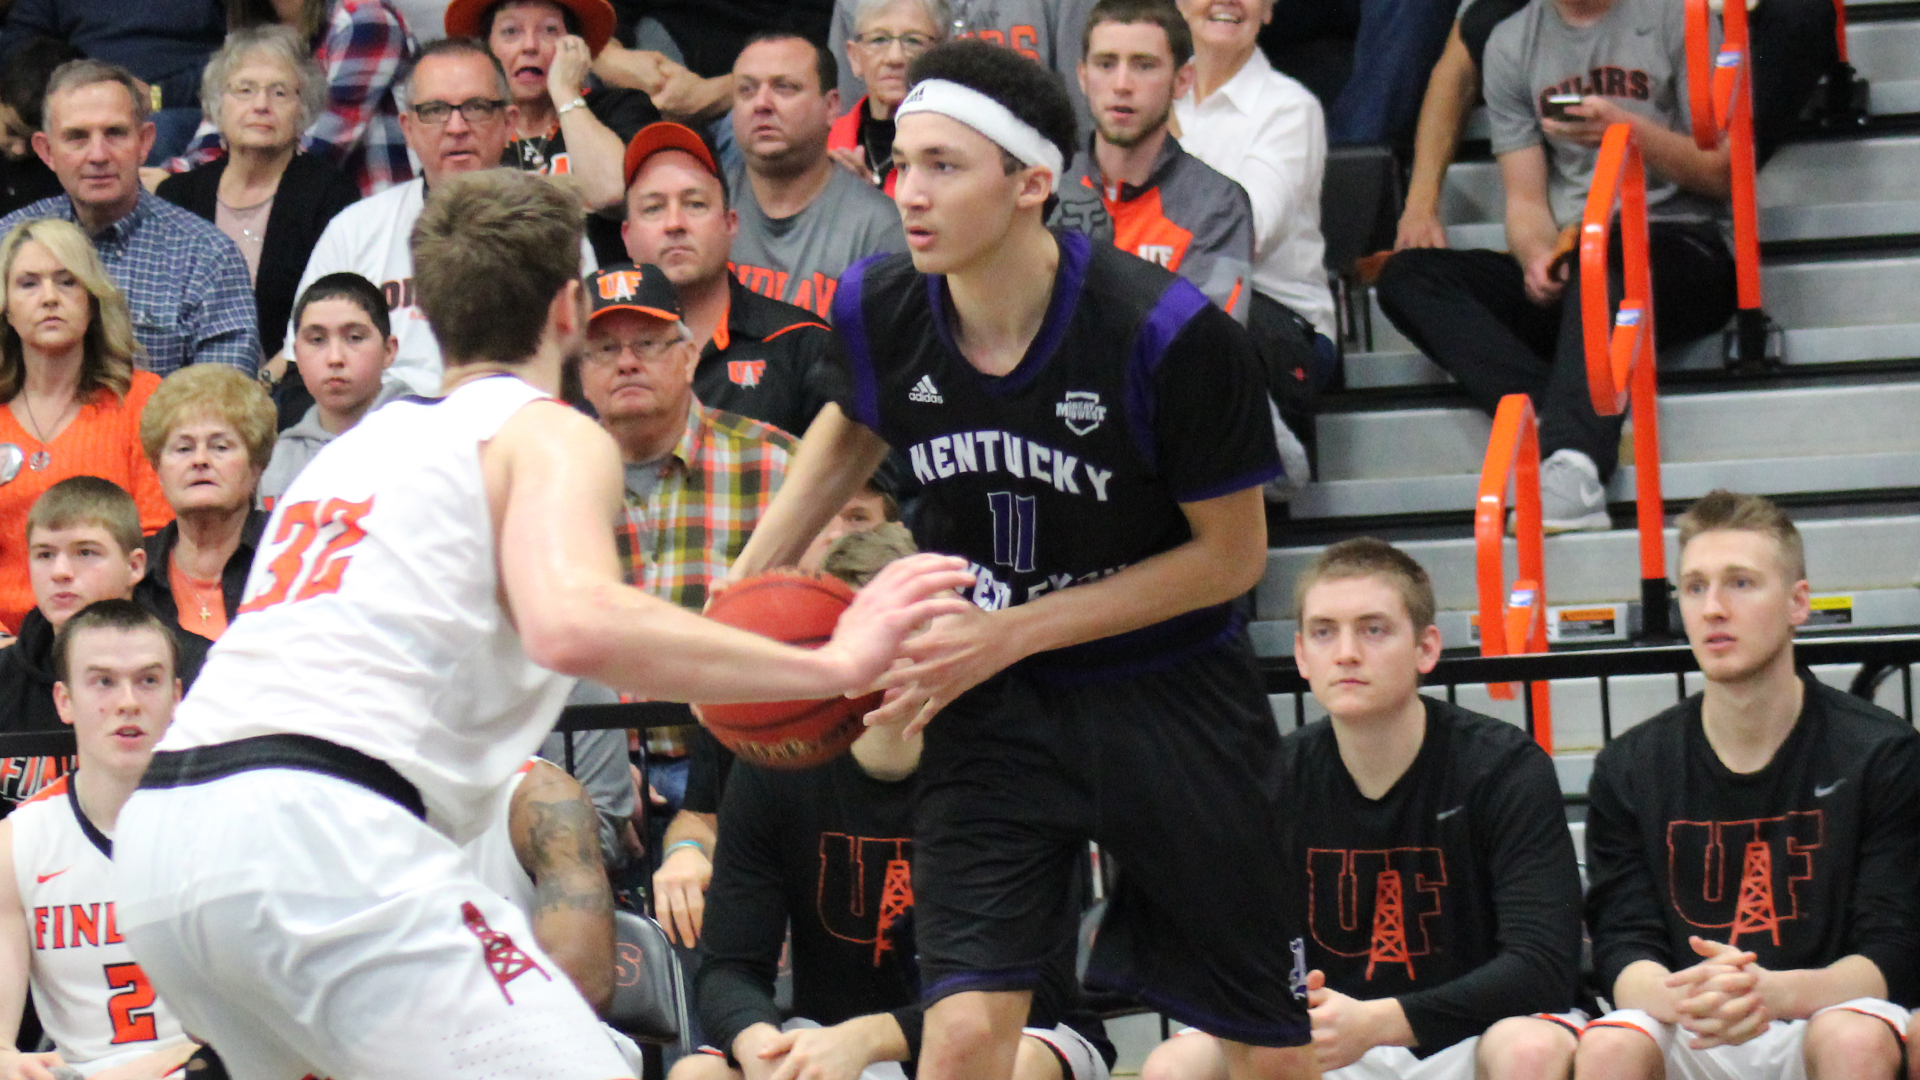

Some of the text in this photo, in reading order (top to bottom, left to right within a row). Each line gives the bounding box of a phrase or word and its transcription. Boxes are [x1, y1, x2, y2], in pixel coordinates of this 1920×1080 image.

[909, 392, 943, 404] adidas
[909, 430, 1112, 501] KENTUCKY
[236, 493, 375, 614] 32
[987, 491, 1036, 573] 11
[103, 962, 158, 1044] 2
